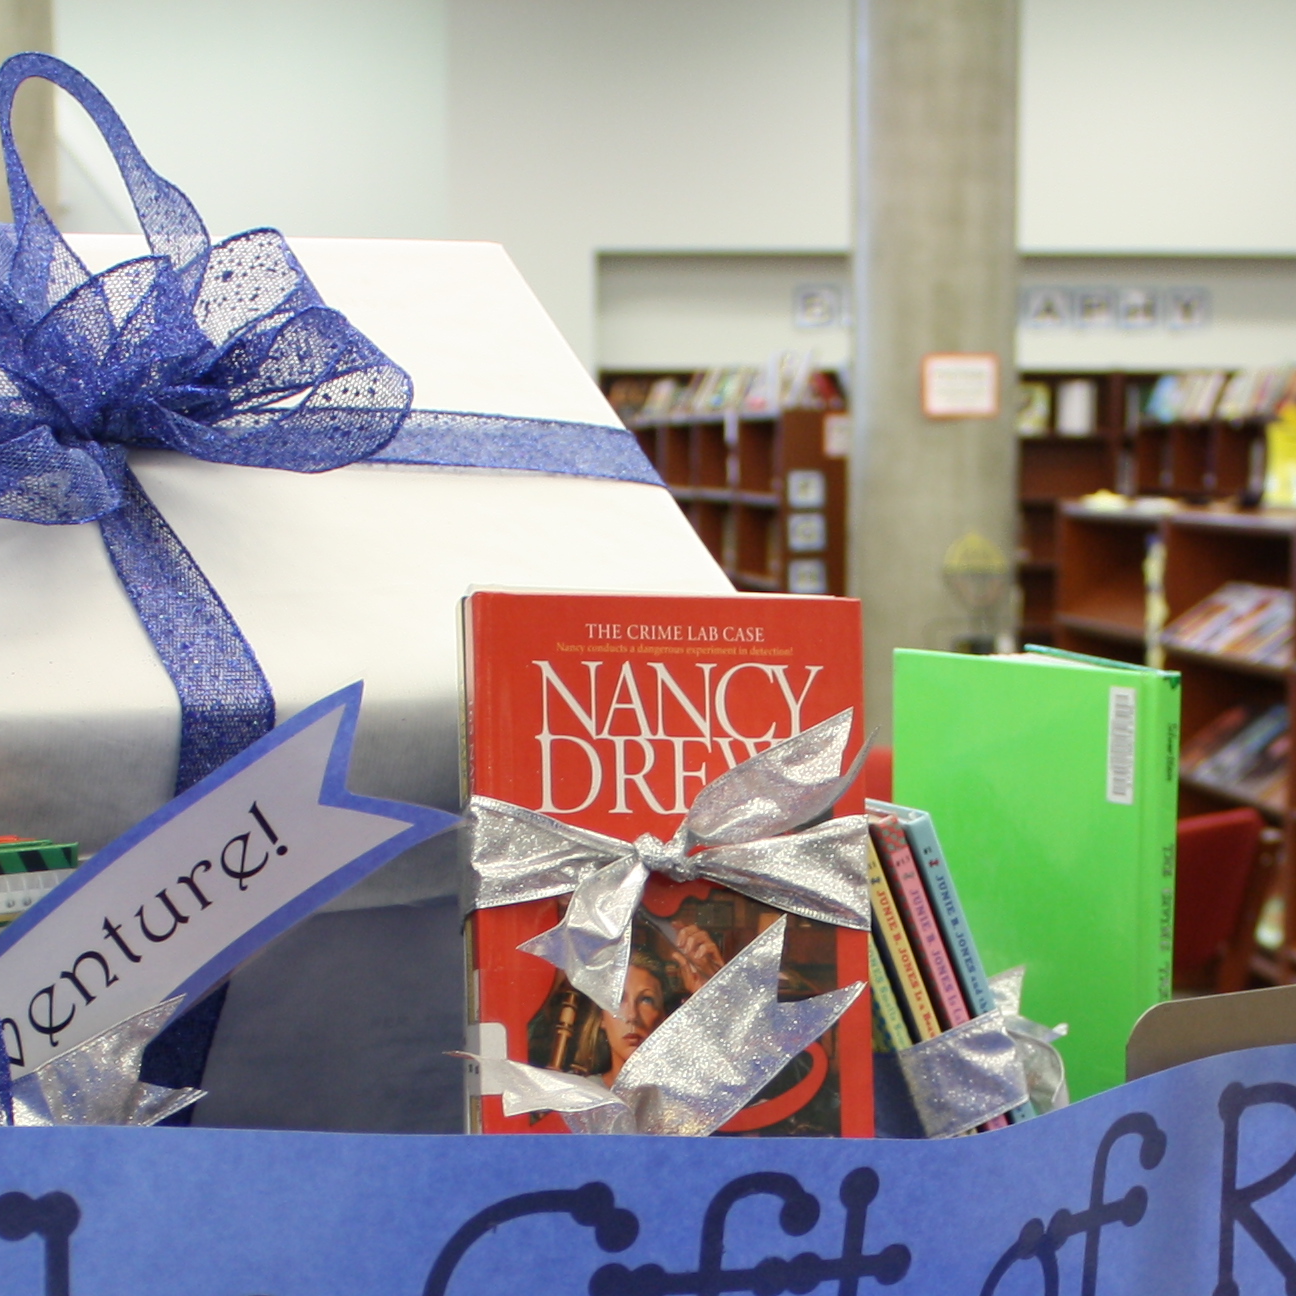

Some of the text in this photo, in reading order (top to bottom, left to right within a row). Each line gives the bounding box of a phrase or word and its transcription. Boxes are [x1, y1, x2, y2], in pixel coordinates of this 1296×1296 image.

[556, 642, 794, 656] Nancy conducts a dangerous experiment in detection!
[585, 623, 765, 642] THE CRIME LAB CASE
[532, 660, 824, 752] NANCY
[876, 889, 898, 931] JUNIE
[899, 947, 919, 993] JONES
[909, 888, 931, 932] JUNIE
[932, 951, 954, 998] JONES
[935, 875, 955, 914] JUNIE
[955, 932, 976, 974] JONES
